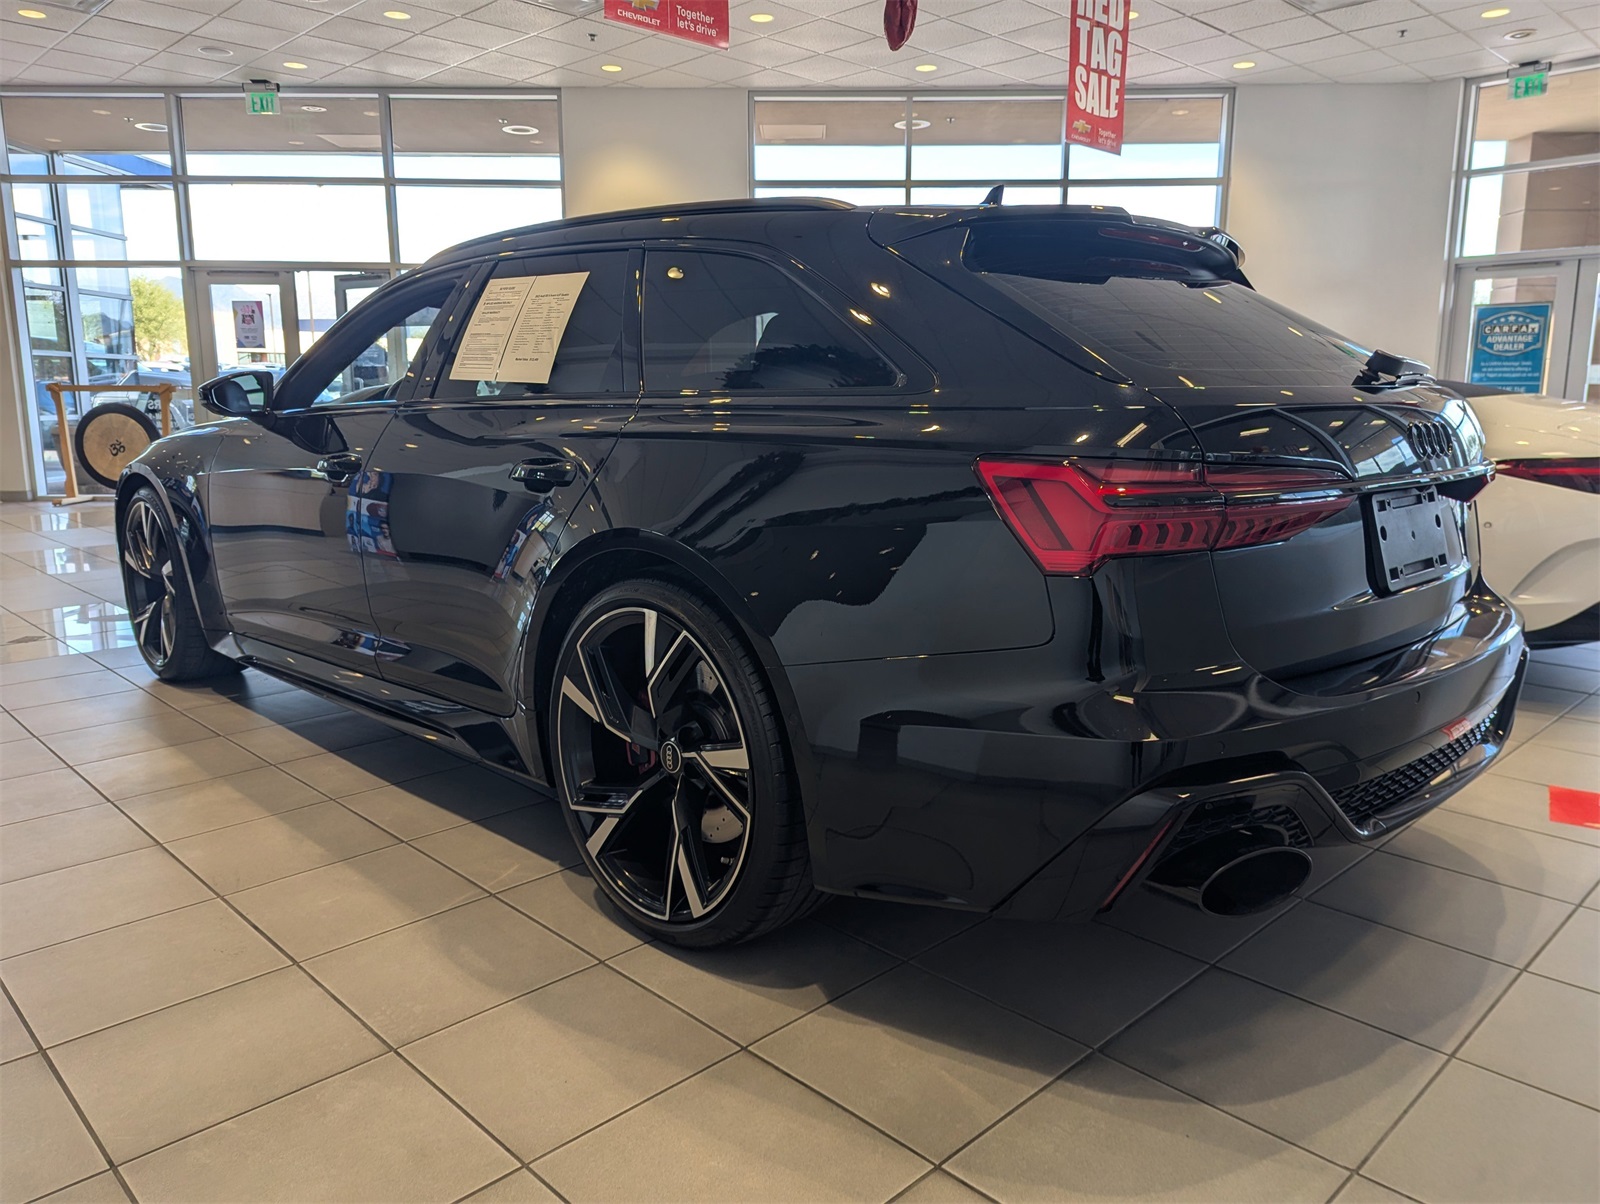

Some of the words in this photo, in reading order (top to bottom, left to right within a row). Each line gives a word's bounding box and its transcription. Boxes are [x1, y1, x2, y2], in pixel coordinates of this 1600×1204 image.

[617, 9, 661, 26] CHEVROLET
[676, 5, 714, 25] Together
[676, 17, 695, 31] let's
[696, 25, 717, 37] drive
[1076, 18, 1123, 78] TAG
[1074, 65, 1120, 118] SALE
[1514, 72, 1545, 100] EXIT
[251, 92, 275, 113] EXIT
[1484, 323, 1539, 335] CARFAX
[1486, 335, 1534, 343] ADVANTAGE
[1493, 343, 1525, 351] DEALER
